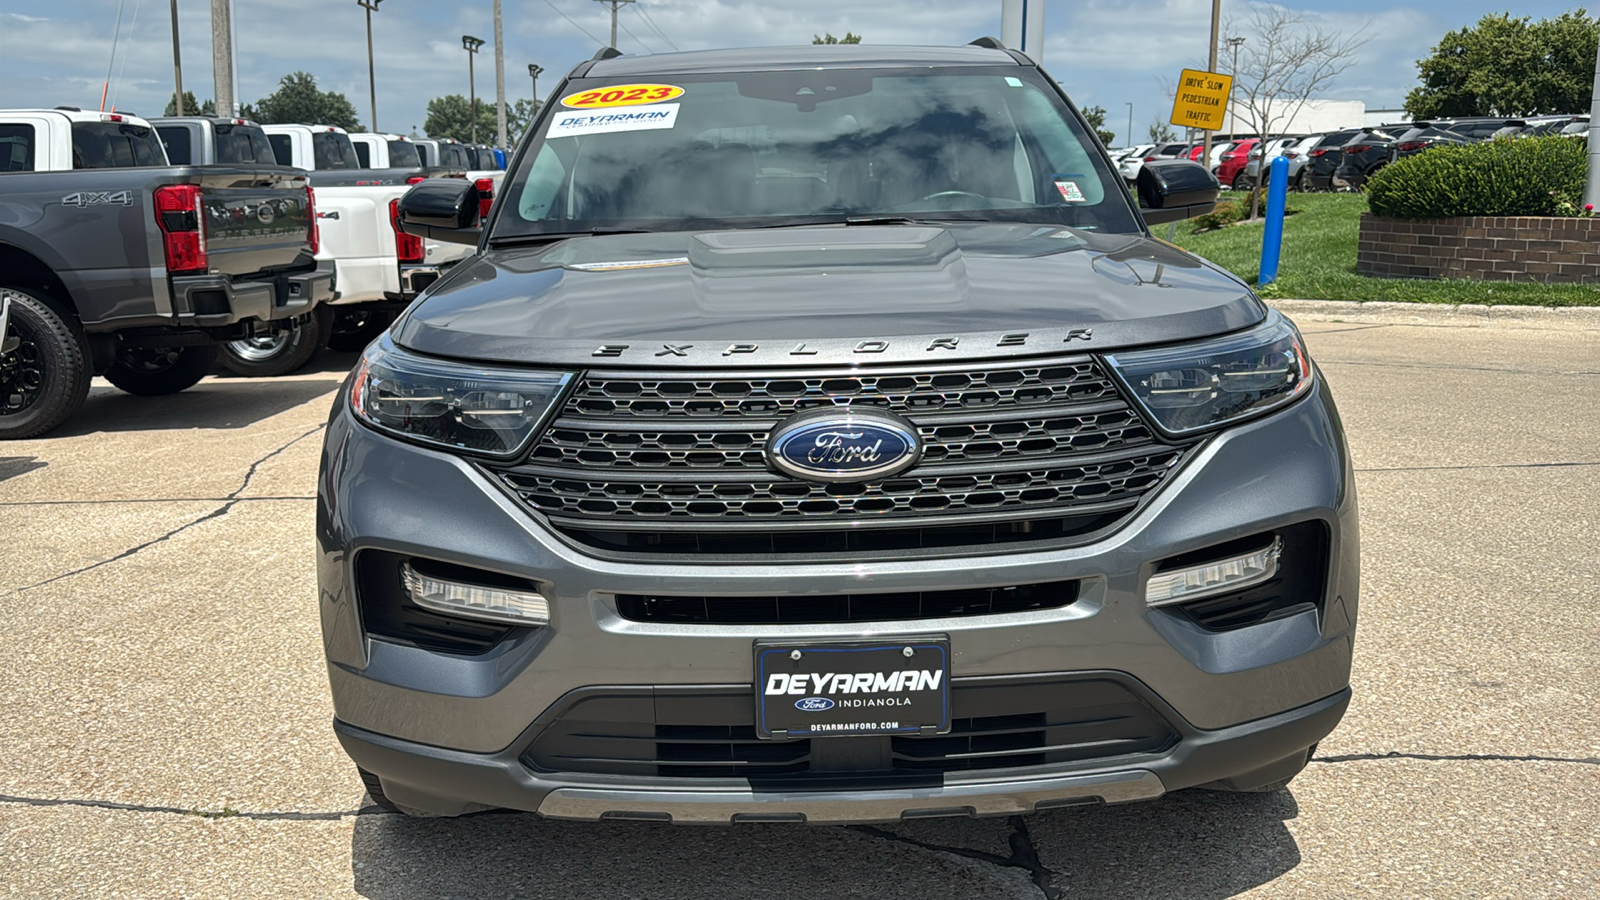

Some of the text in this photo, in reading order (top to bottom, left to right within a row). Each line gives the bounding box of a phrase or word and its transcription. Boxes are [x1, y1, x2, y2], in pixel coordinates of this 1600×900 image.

[1185, 77, 1223, 91] DRIVE SLOW
[573, 88, 673, 105] 2023
[1182, 93, 1220, 107] PEDESTRIAN
[559, 111, 670, 126] DEYARMAN
[1185, 110, 1211, 122] TRAFFIC
[566, 121, 611, 129] CERTIFIED
[62, 190, 133, 208] 4X4
[592, 328, 1093, 356] EXPLORER
[807, 431, 883, 464] Ford
[765, 670, 943, 695] DEYARMAN
[802, 698, 911, 709] Ford INDIANOLA
[811, 722, 899, 731] DEYARMANFORD.COM
